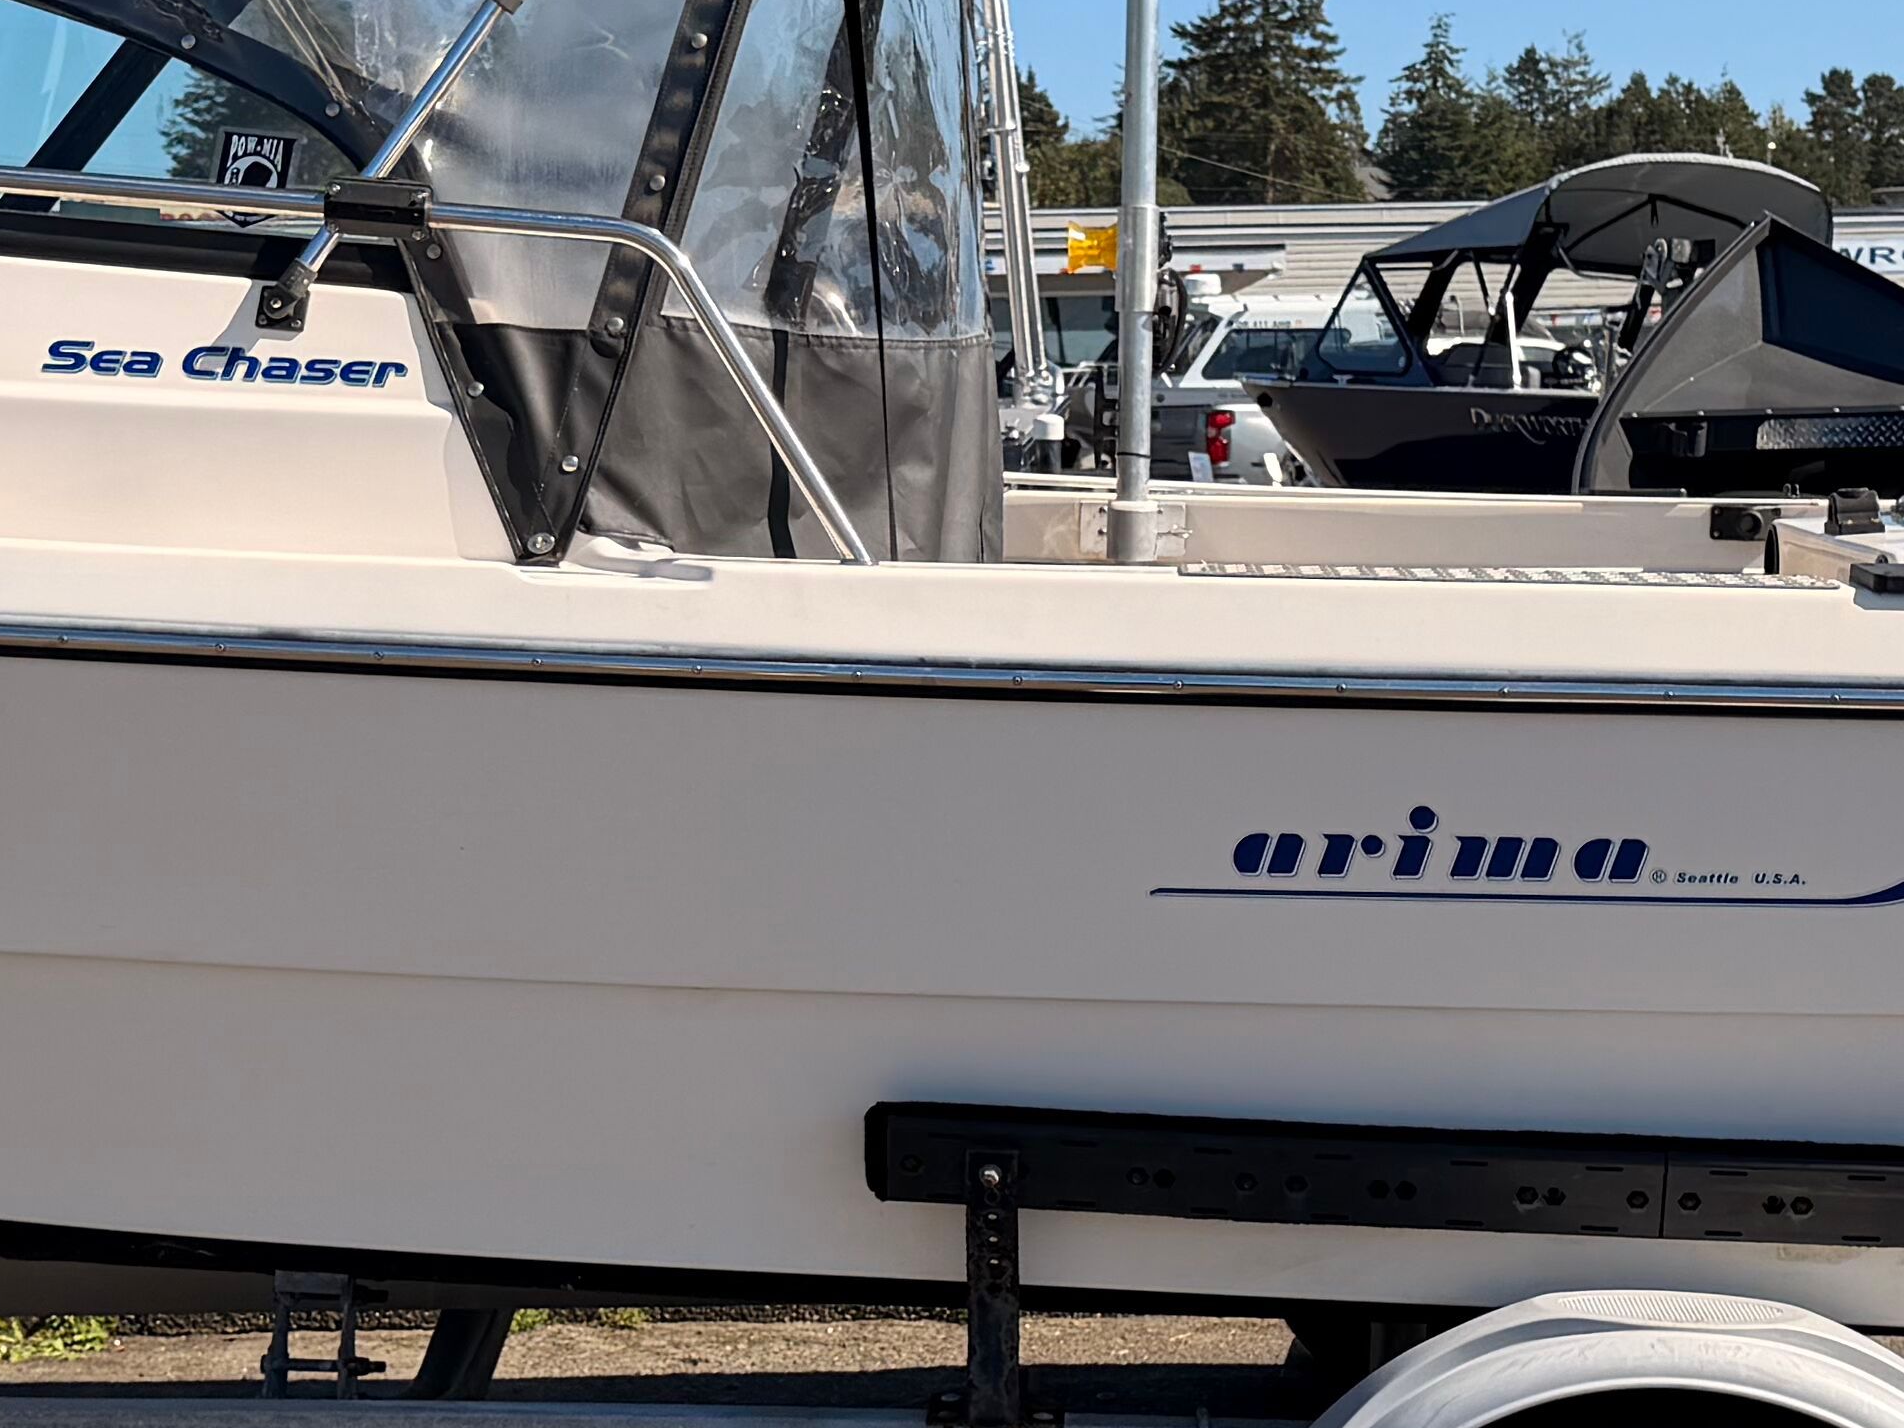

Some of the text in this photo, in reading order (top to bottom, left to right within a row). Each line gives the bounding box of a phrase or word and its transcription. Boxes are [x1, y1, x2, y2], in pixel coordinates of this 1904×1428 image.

[41, 340, 408, 388] Sea Chaser
[1232, 805, 1806, 884] arima Seattle U.S.A.
